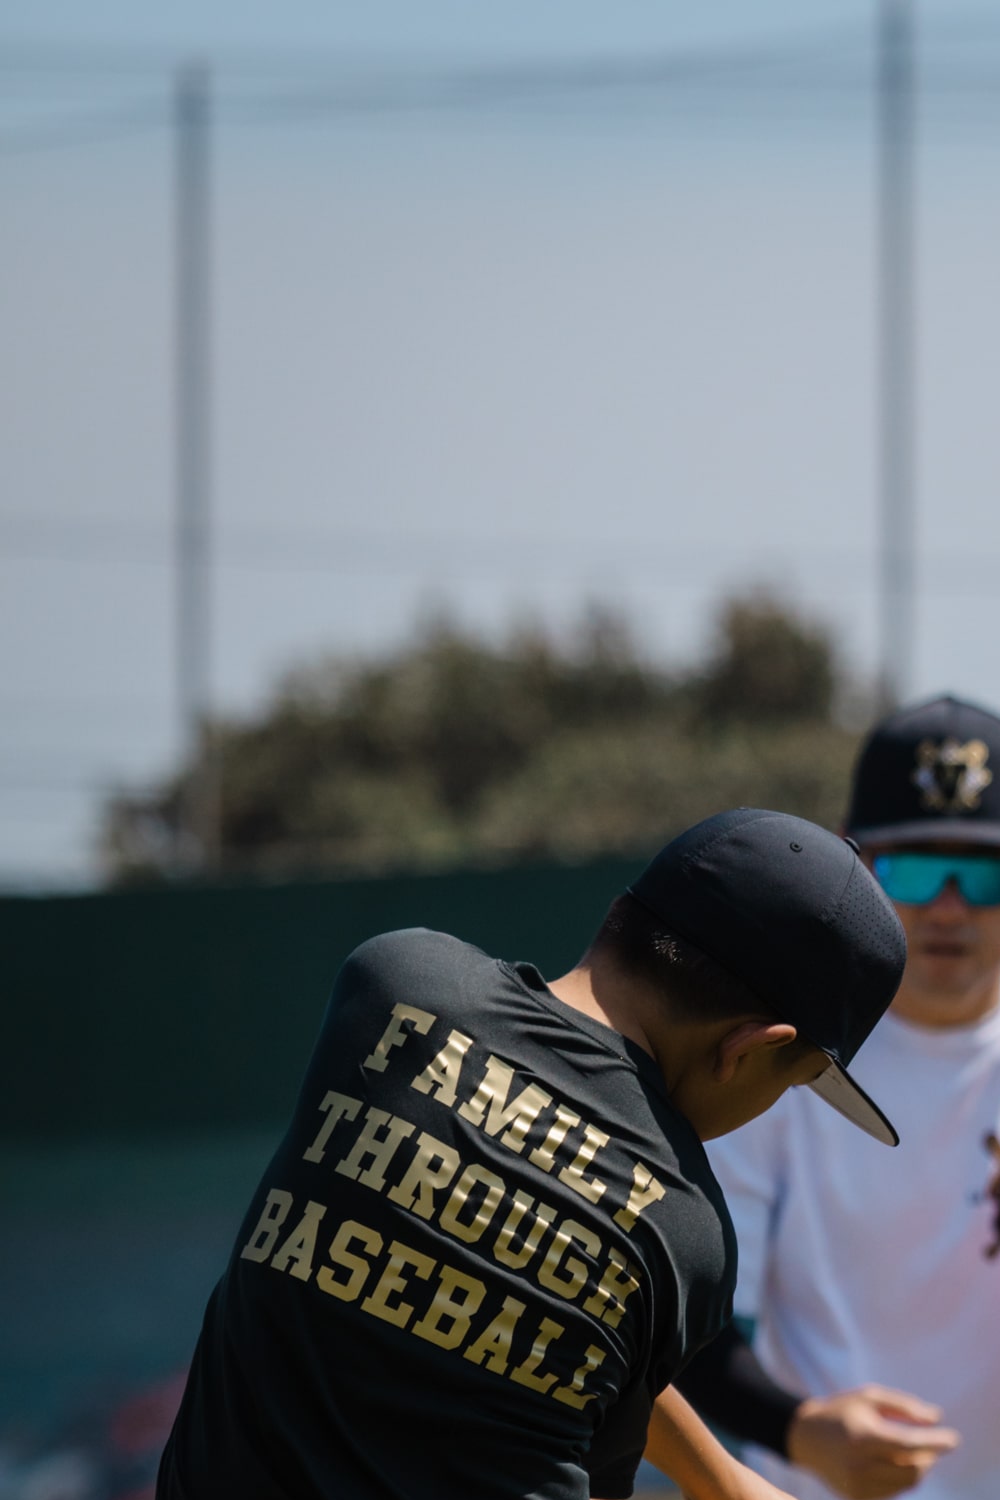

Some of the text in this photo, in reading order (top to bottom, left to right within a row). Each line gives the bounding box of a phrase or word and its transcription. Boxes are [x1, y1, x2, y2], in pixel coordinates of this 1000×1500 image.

[303, 1090, 642, 1329] THROUGH
[363, 1002, 666, 1232] FAMILY
[241, 1188, 607, 1411] BASEBALL
